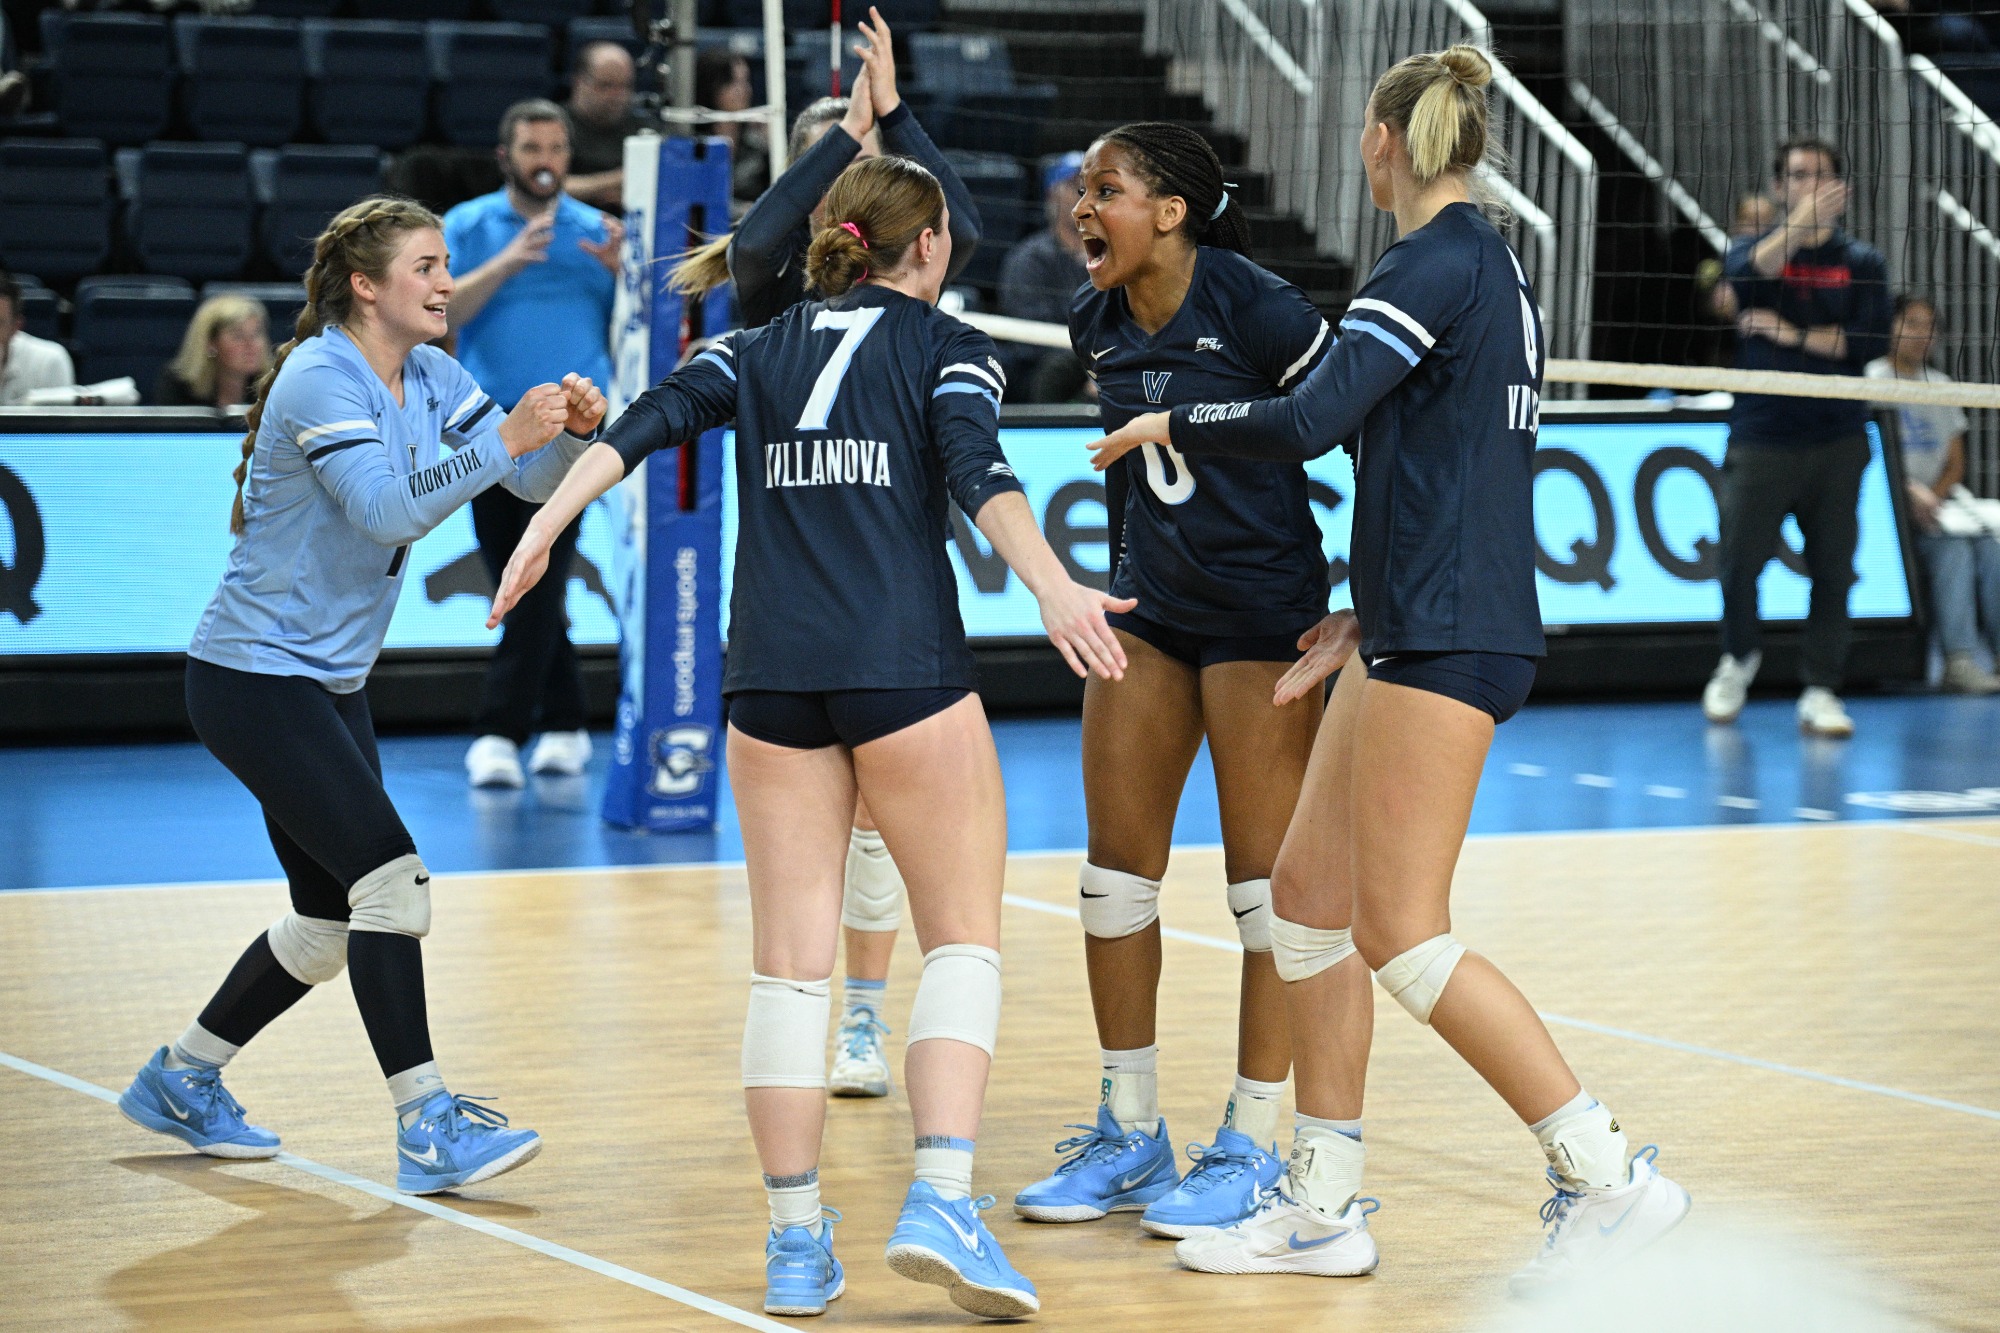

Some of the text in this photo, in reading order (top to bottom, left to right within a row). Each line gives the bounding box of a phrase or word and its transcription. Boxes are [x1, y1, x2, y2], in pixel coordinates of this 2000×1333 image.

[1196, 337, 1218, 345] BIG
[795, 307, 887, 431] 7
[1143, 371, 1172, 403] V
[409, 448, 482, 499] VILLANOVA
[764, 438, 892, 489] VILLANOVA
